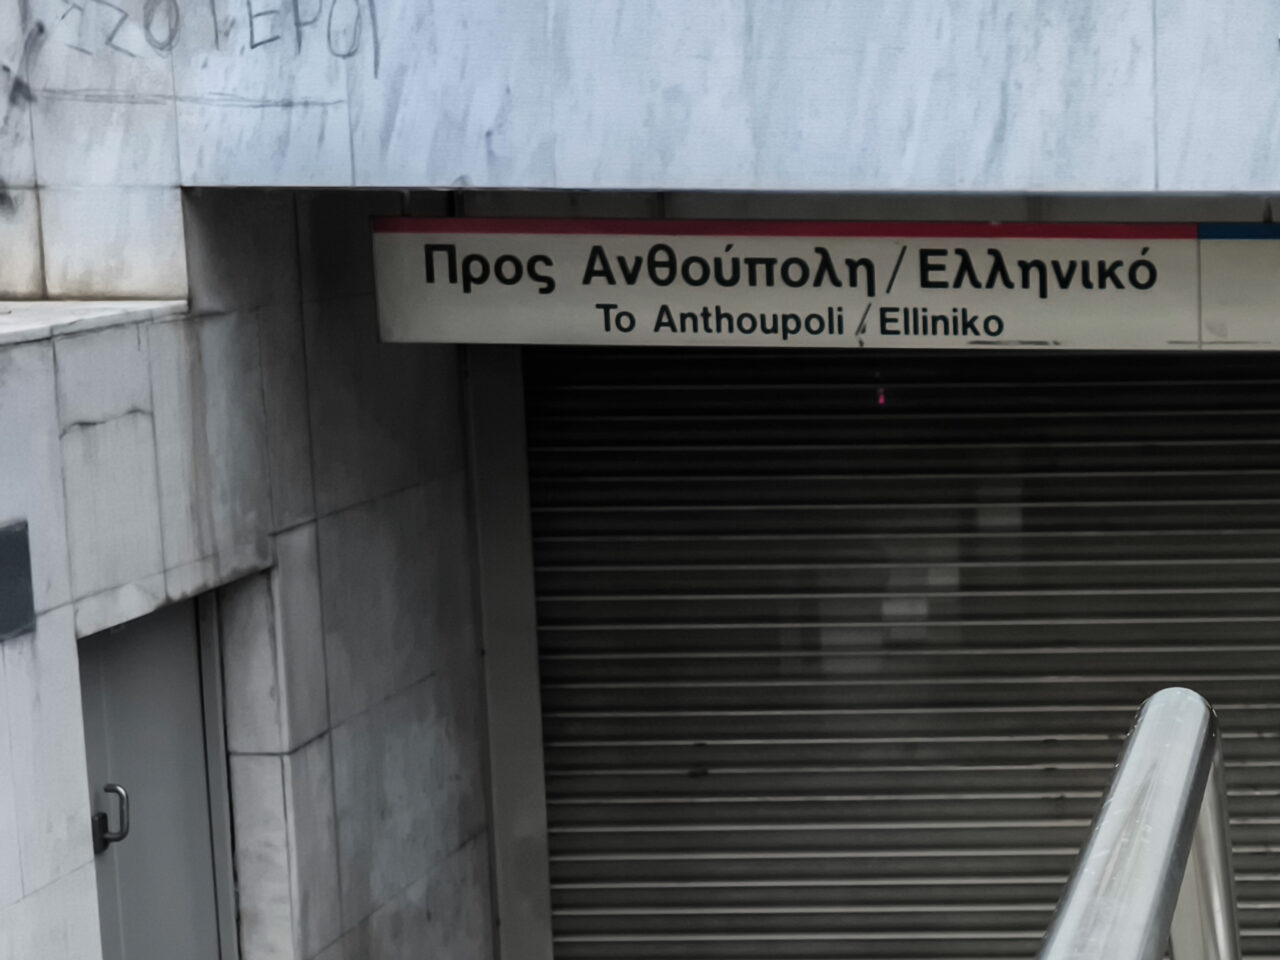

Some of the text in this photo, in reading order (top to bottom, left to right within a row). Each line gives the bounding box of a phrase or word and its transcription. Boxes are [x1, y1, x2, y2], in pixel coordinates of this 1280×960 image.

[423, 242, 556, 295] Προς
[581, 242, 876, 298] Ανθούπολη
[918, 246, 1158, 299] Ελληνικό
[595, 303, 637, 334] To
[653, 304, 845, 341] Anthoupoli
[879, 306, 1005, 337] Elliniko
